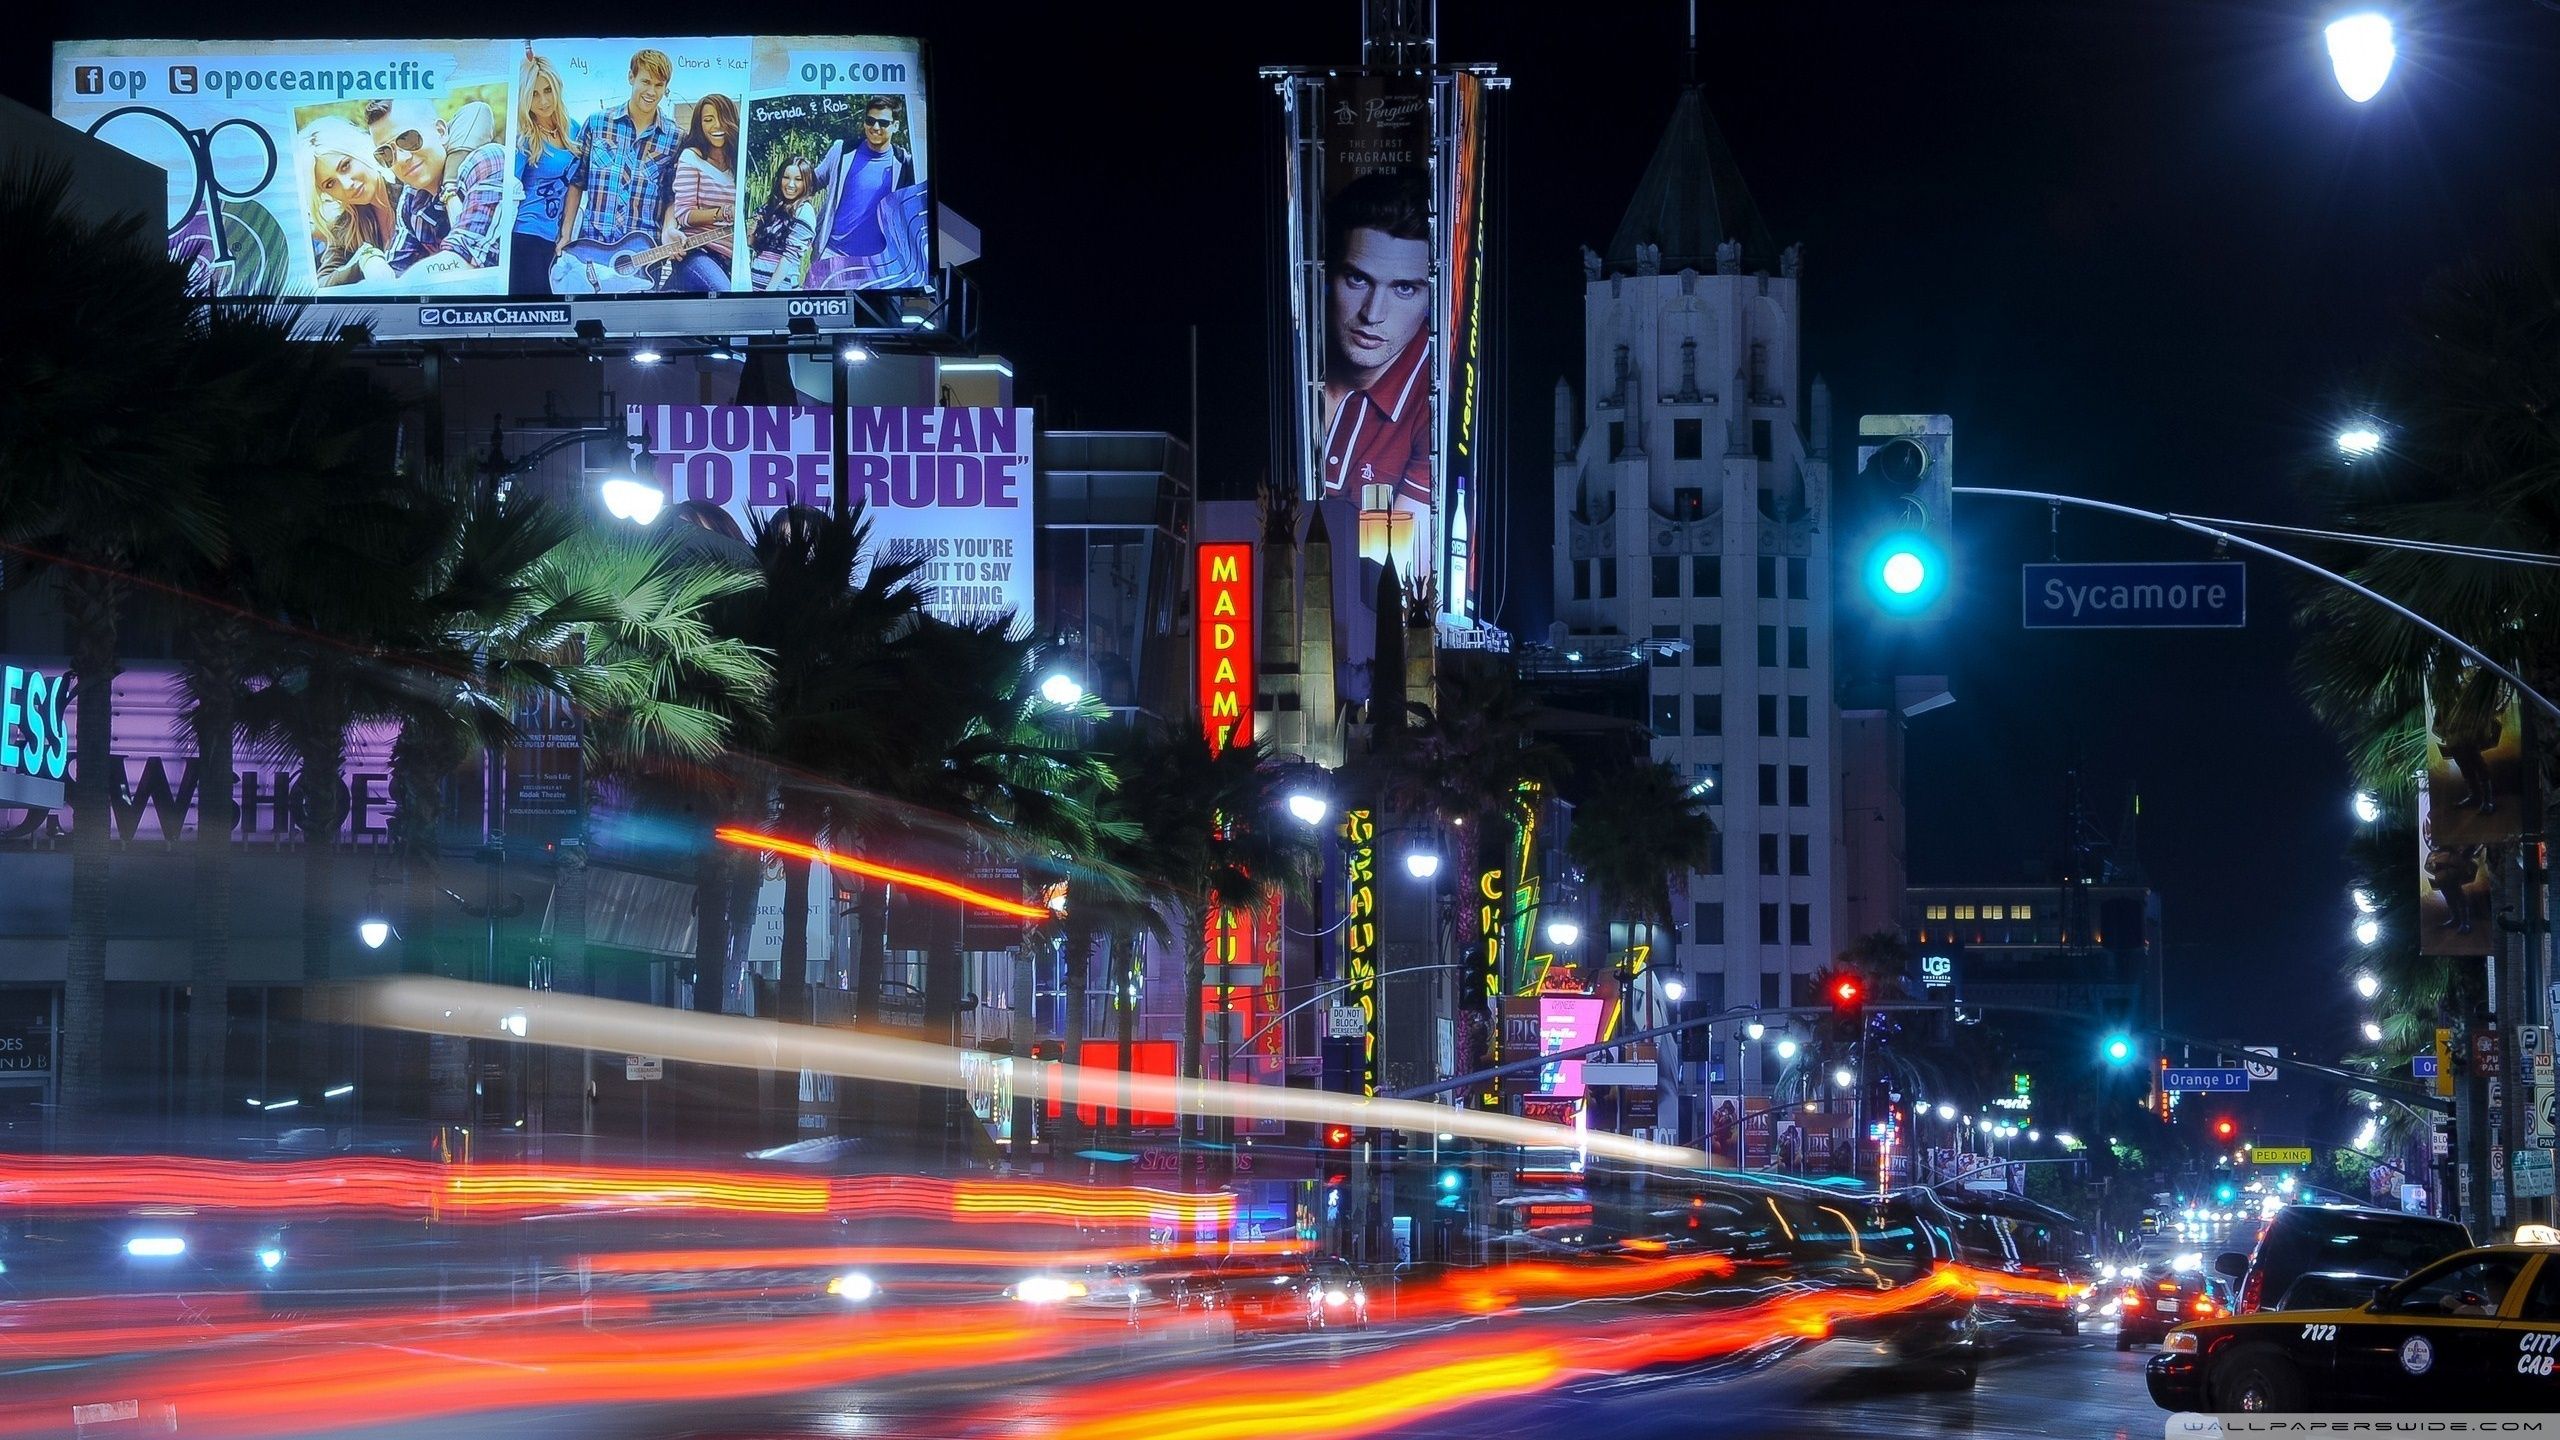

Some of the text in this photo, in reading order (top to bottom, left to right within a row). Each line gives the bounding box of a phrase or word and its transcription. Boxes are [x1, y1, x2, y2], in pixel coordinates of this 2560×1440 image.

[569, 57, 589, 75] Aly
[677, 55, 710, 69] Chord
[727, 57, 749, 70] Kat
[108, 70, 147, 99] op
[205, 61, 435, 99] opoceanpacific
[801, 61, 906, 90] op.com
[755, 105, 806, 122] Brenda
[823, 99, 848, 114] Rob
[1365, 98, 1425, 123] Penguin
[1350, 139, 1403, 148] THE FIRST
[1340, 151, 1412, 163] FRAGRANCE
[1355, 166, 1397, 175] FOR MEN
[788, 300, 848, 316] 001161
[669, 404, 833, 452] DON'T
[848, 406, 1016, 453] MEAN
[750, 454, 830, 506] BE
[889, 538, 1014, 558] MEANS YOU'RE
[954, 561, 976, 581] TO
[980, 561, 1012, 581] SAY
[2043, 578, 2226, 617] Sycamore
[1922, 956, 1951, 976] UGG
[1333, 1009, 1361, 1018] DO NOT
[1335, 1018, 1358, 1027] BLOCK
[2170, 1073, 2241, 1089] Orange Dr
[2256, 1150, 2307, 1161] PED XING
[2301, 1323, 2337, 1342] 7172
[2519, 1332, 2560, 1354] CITY
[2517, 1354, 2555, 1376] CAB
